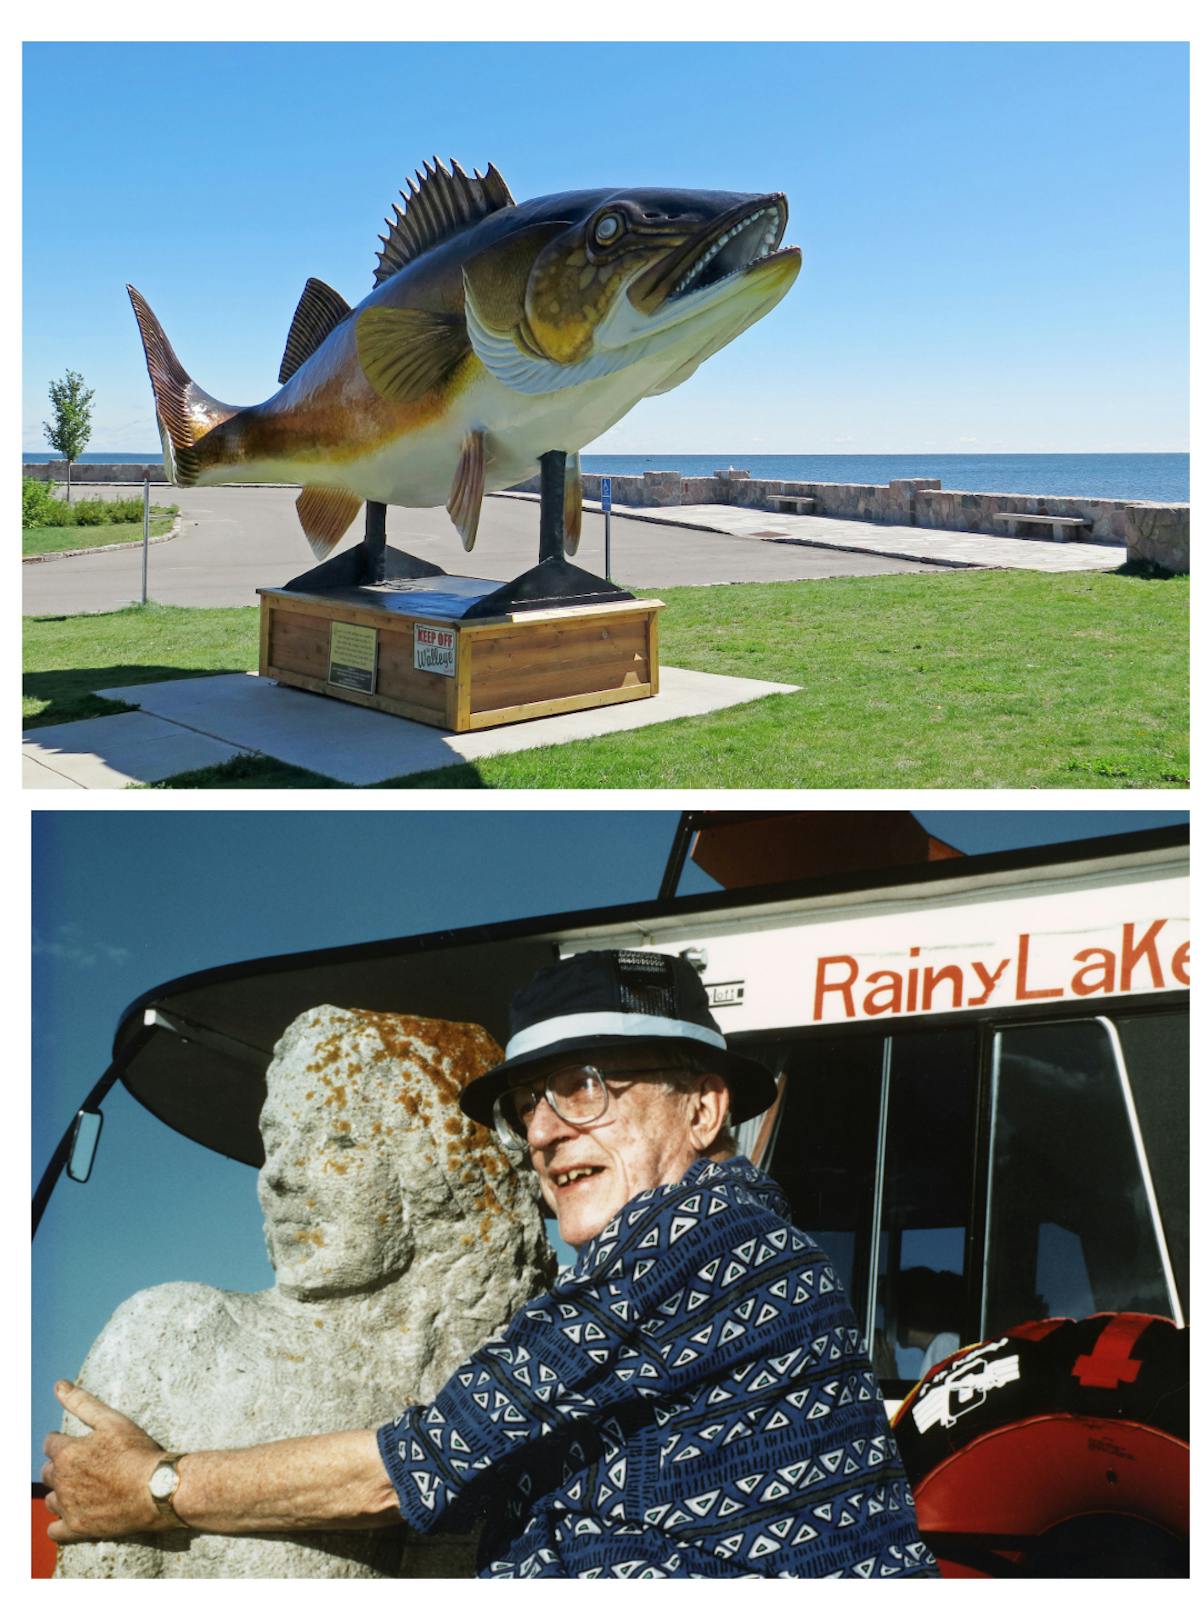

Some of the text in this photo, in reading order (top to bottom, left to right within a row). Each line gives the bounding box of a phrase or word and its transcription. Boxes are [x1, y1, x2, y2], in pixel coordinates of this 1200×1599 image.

[418, 629, 453, 647] KEEP OFF
[417, 648, 453, 669] Walleye
